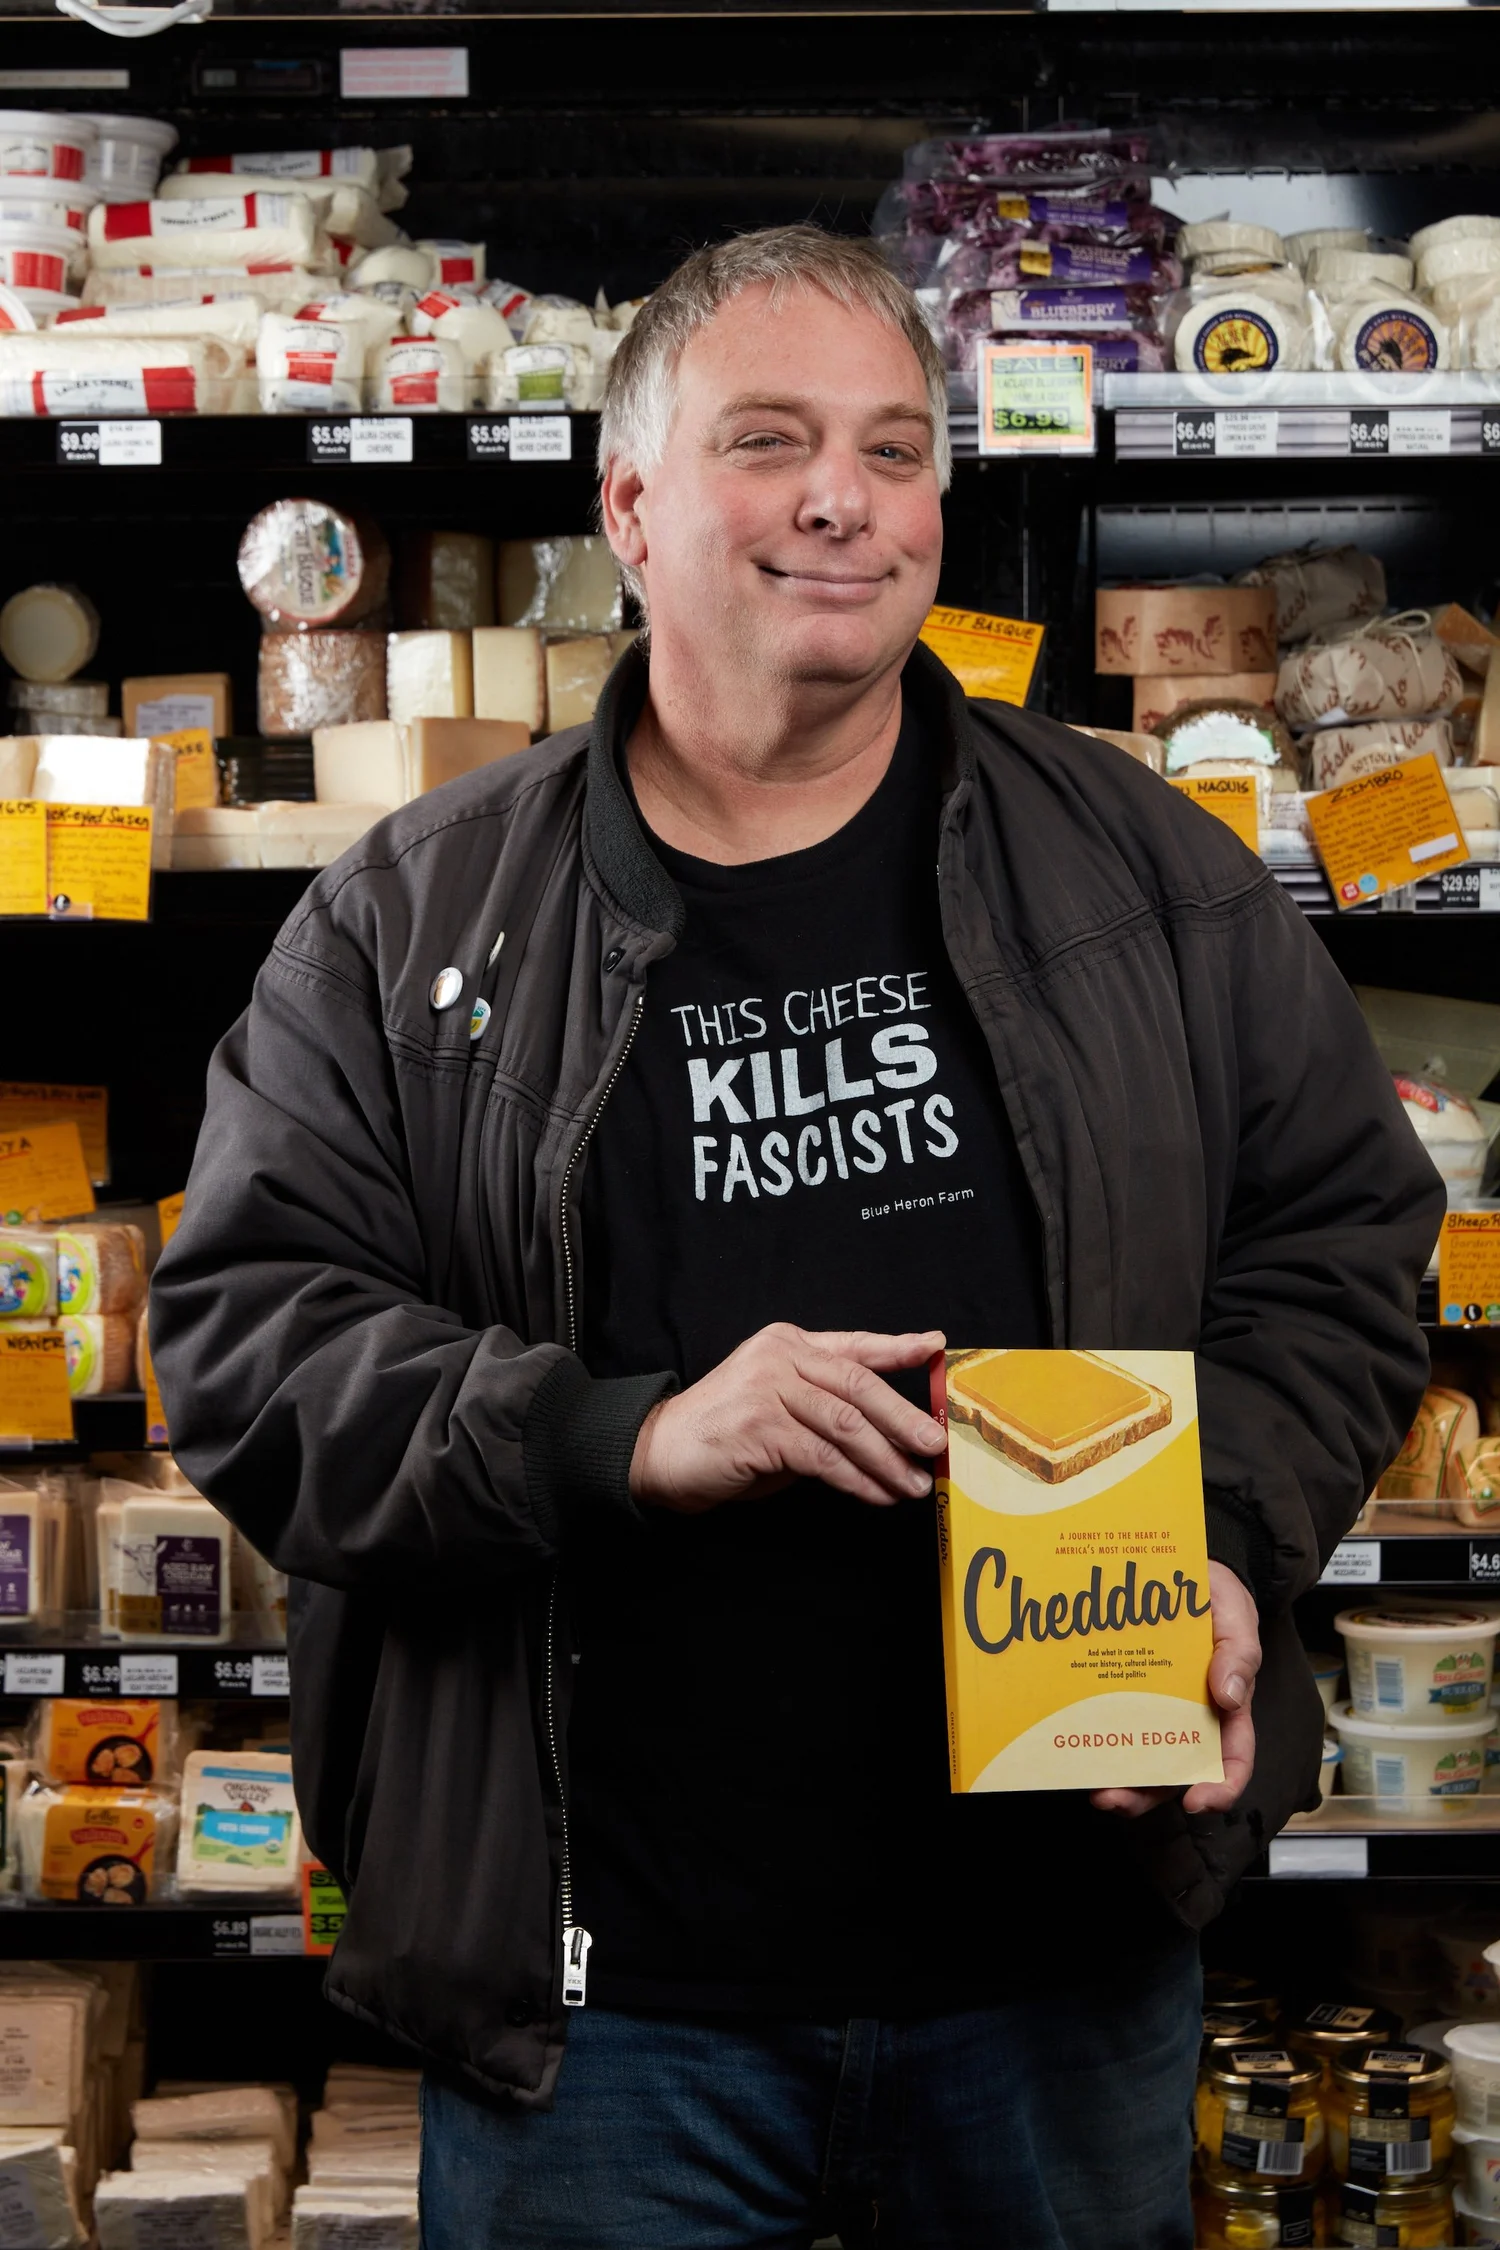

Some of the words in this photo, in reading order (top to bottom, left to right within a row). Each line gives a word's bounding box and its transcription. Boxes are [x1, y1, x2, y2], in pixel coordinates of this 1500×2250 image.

[1031, 303, 1116, 318] BLUEBERRY
[993, 356, 1084, 374] SALE!
[993, 410, 1070, 429] $6.99
[312, 425, 351, 445] $5.99
[471, 425, 510, 444] $5.99
[1177, 421, 1215, 440] $6.49
[1350, 423, 1388, 441] $6.49
[61, 432, 100, 451] $9.99
[317, 446, 347, 454] Each
[476, 445, 505, 453] Each
[1182, 442, 1211, 450] Each
[66, 452, 96, 460] Each
[972, 616, 1036, 640] BASQUE
[1328, 769, 1404, 804] ZIMBRO
[1442, 874, 1479, 893] $29.99
[671, 998, 767, 1047] THIS
[784, 971, 932, 1036] CHEESE
[687, 1023, 938, 1124] KILLS
[692, 1093, 960, 1203] FASCISTS
[861, 1204, 891, 1220] Blue
[894, 1197, 935, 1212] Heron
[938, 1187, 975, 1203] Farm
[1447, 1212, 1490, 1232] Sheep
[937, 1491, 950, 1567] Cheddar
[1068, 1532, 1101, 1540] JOURNEY
[1105, 1532, 1114, 1540] TO
[1161, 1531, 1171, 1539] OF
[1055, 1544, 1095, 1554] AMERICA'S
[1099, 1546, 1119, 1554] MOST
[1122, 1546, 1148, 1554] ICONIC
[1151, 1545, 1177, 1554] CHEESE
[963, 1546, 1212, 1655] Cheddar
[1088, 1648, 1099, 1657] And
[1101, 1648, 1116, 1656] what
[1118, 1648, 1122, 1656] it
[1136, 1647, 1146, 1655] tell
[215, 1661, 252, 1679] $6.99
[1070, 1660, 1087, 1668] about
[1100, 1659, 1123, 1669] history,
[1124, 1658, 1147, 1667] cultural
[1148, 1658, 1173, 1668] identity,
[82, 1665, 120, 1683] $6.99
[1097, 1671, 1109, 1679] and
[1110, 1671, 1124, 1679] food
[1125, 1670, 1147, 1680] politics
[1053, 1732, 1134, 1749] GORDON
[1142, 1730, 1202, 1747] EDGAR
